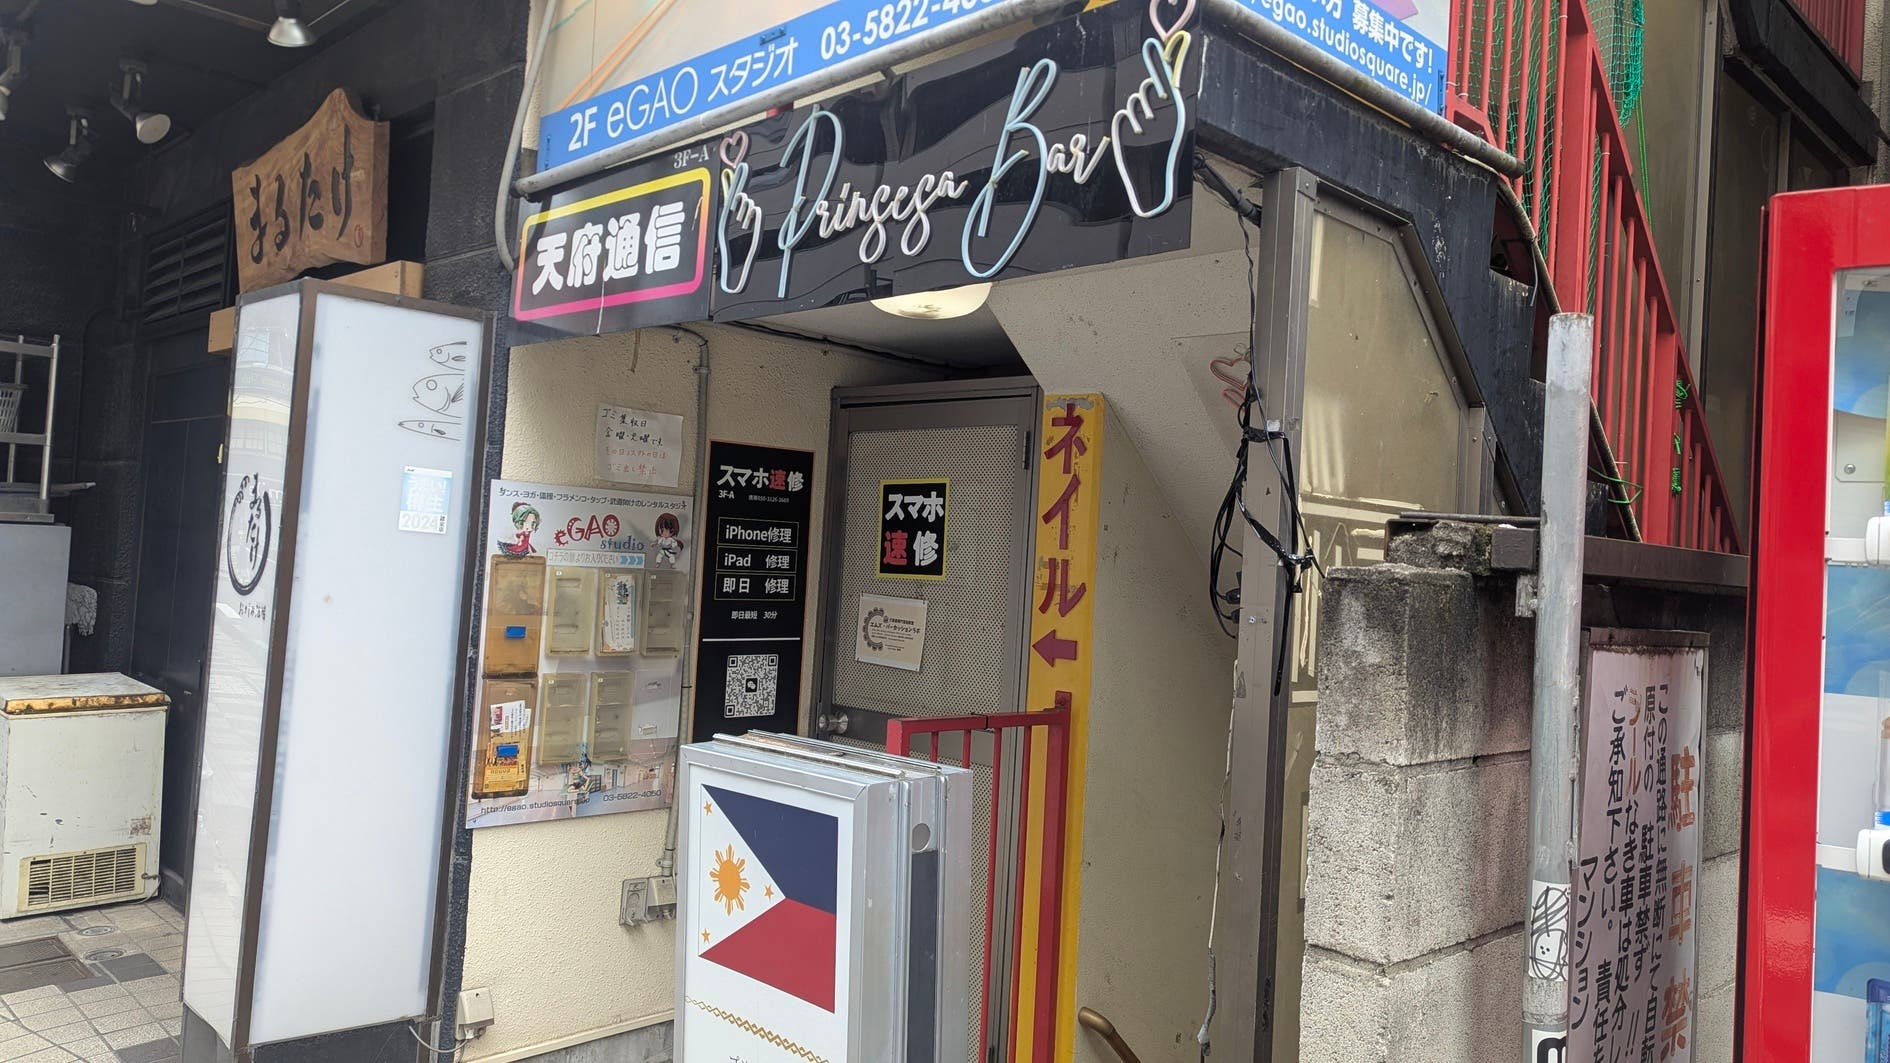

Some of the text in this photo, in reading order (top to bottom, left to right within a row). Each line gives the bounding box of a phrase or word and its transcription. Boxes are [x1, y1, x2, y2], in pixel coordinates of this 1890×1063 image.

[1352, 0, 1433, 73] 募集中です!
[568, 105, 598, 151] 2F
[607, 66, 699, 138] eGAO
[708, 37, 799, 102] スタジオ
[673, 145, 709, 168] 3F-A
[961, 58, 1112, 278] Bar
[249, 123, 354, 264] まるたけ
[532, 201, 685, 296] 天府通信
[716, 465, 804, 492] スマホ速修
[718, 489, 735, 499] 3F-A
[885, 491, 944, 522] スマホ
[1038, 403, 1087, 617] ネイル
[554, 514, 620, 546] eGAO
[600, 535, 645, 550] studio
[725, 525, 792, 543] iPhone修理
[724, 553, 790, 569] iPad 修理
[883, 530, 939, 567] 速修
[722, 577, 789, 594] 即日 修理
[763, 611, 778, 620] 30分
[1644, 686, 1656, 792] 原付の
[1571, 856, 1599, 1031] マンション
